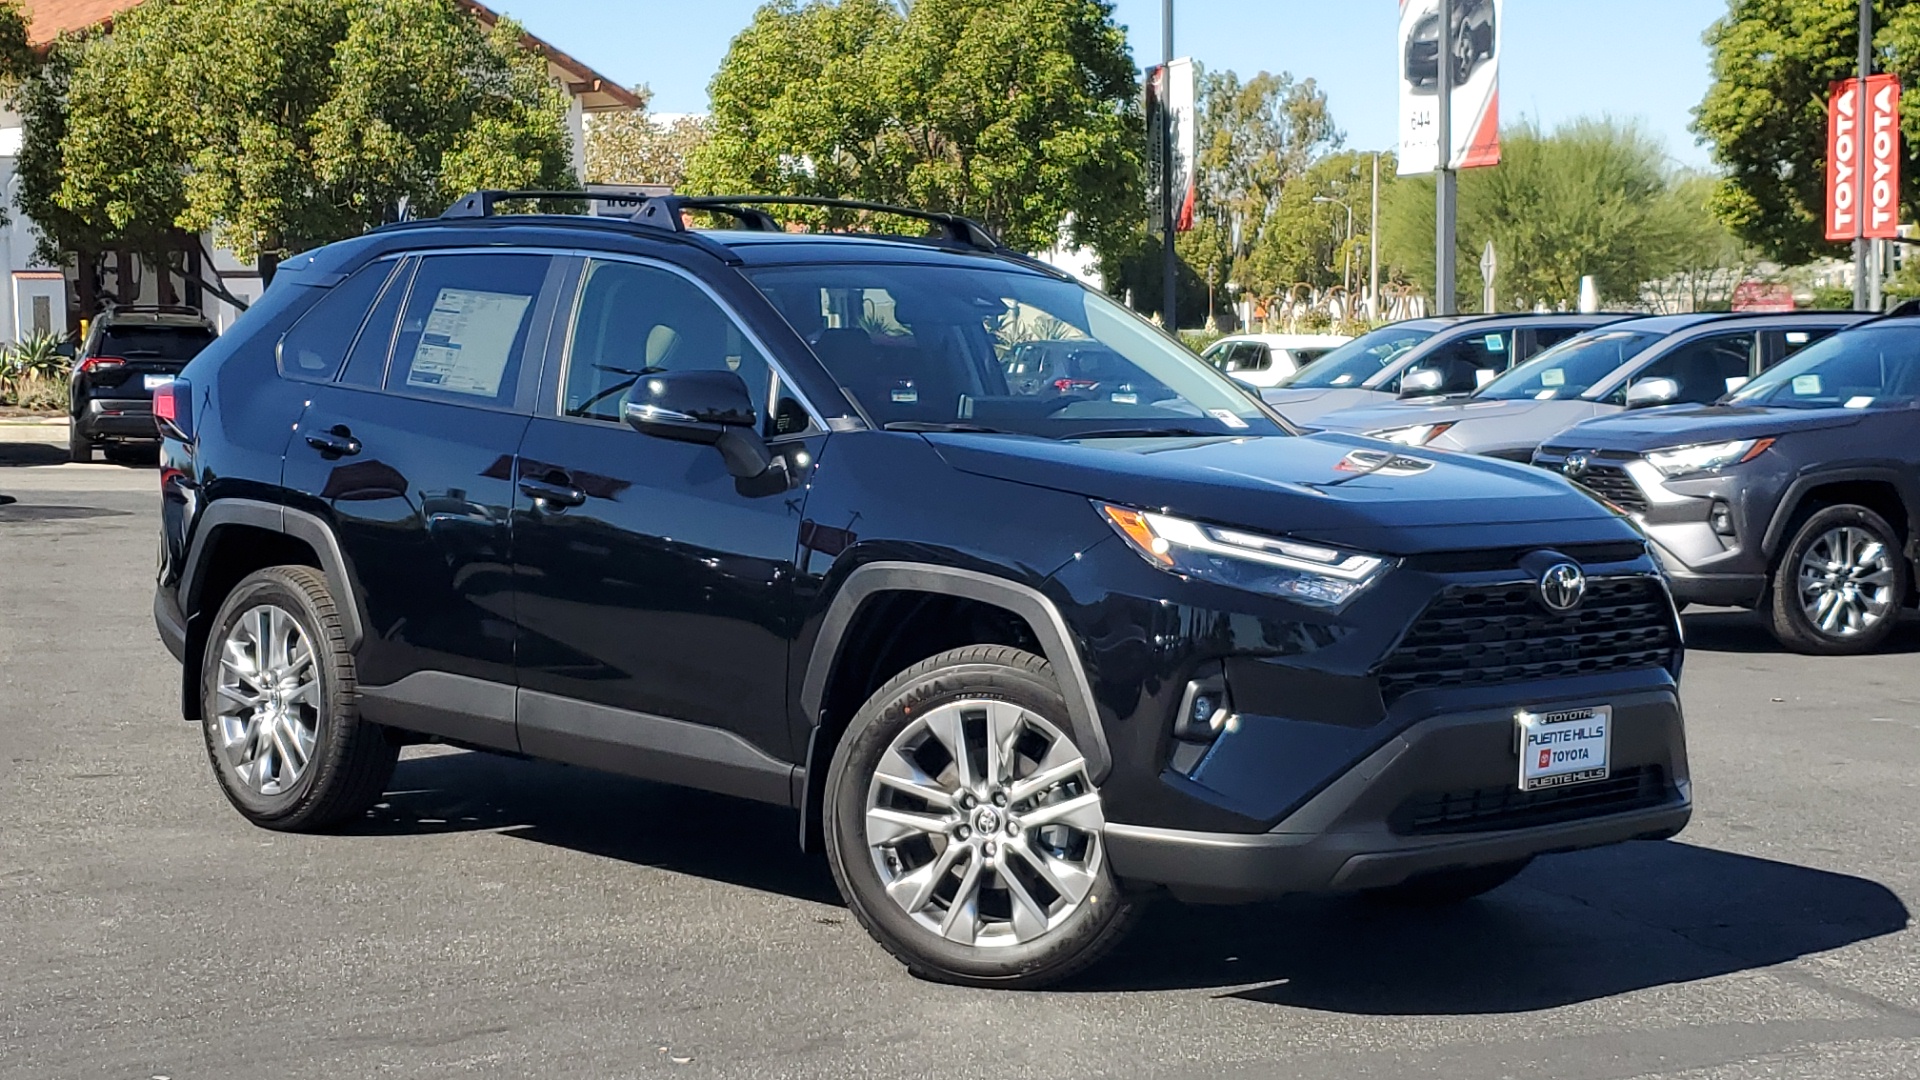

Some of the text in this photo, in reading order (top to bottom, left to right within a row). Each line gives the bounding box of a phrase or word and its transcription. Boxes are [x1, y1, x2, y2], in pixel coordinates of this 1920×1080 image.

[1835, 89, 1855, 231] TOYOTA
[1872, 85, 1892, 230] TOYOTA
[1548, 710, 1592, 723] TOYOTA
[1528, 726, 1604, 746] PUENTE HILLS
[1553, 748, 1589, 763] TOYOTA
[1528, 769, 1605, 789] PUENTE HILLS
